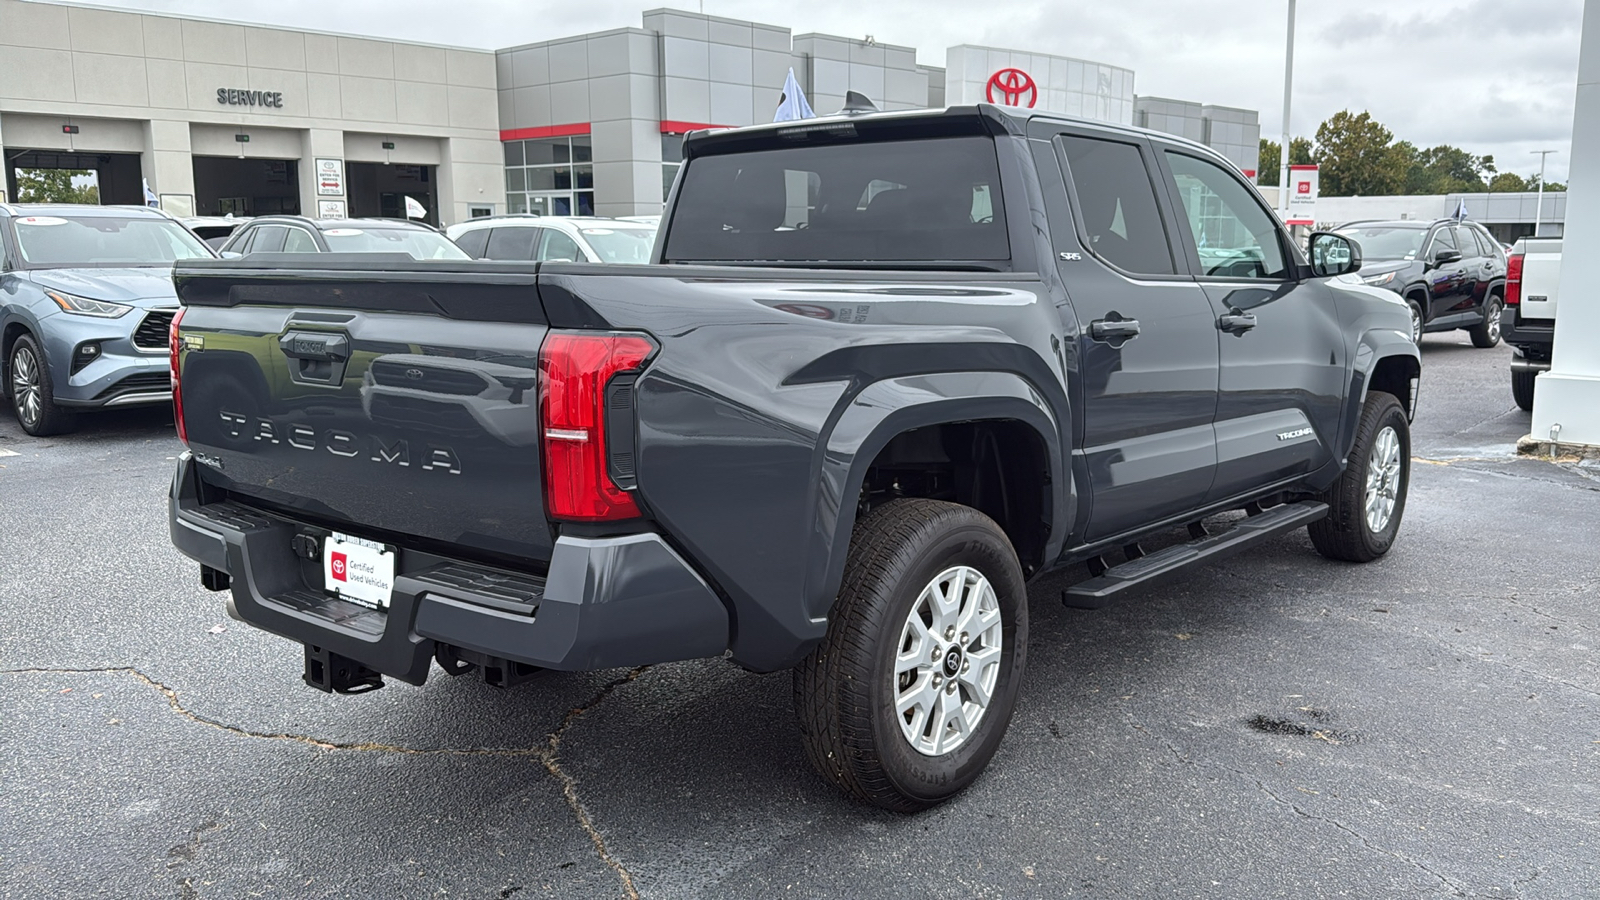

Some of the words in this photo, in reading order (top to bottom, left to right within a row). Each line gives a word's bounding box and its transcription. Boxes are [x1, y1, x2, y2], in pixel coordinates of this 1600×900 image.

[216, 87, 283, 108] SERVICE
[295, 341, 327, 356] TOYOTA
[1276, 427, 1313, 440] TACOMA
[219, 410, 461, 474] TACOMA
[349, 560, 375, 574] Certified
[349, 572, 364, 583] Used
[364, 576, 389, 590] Vehicles
